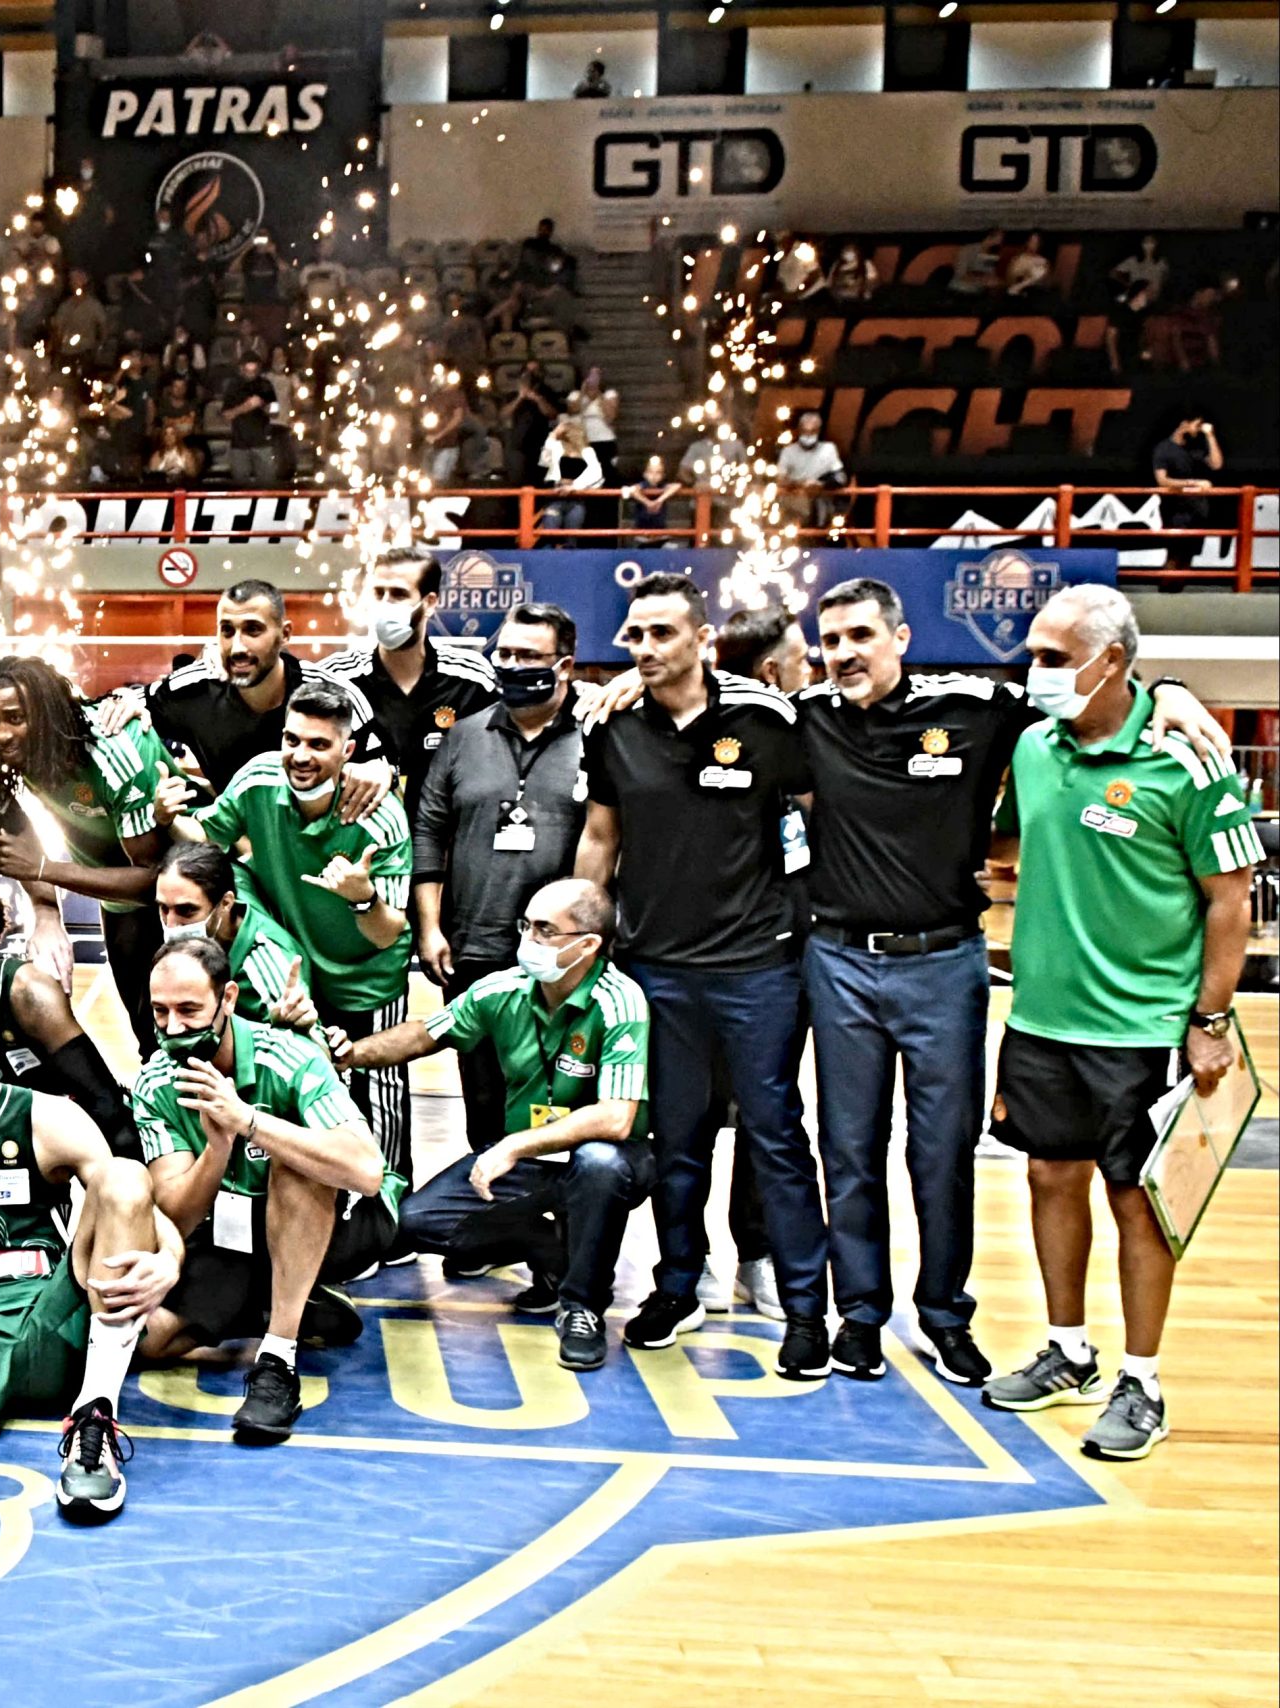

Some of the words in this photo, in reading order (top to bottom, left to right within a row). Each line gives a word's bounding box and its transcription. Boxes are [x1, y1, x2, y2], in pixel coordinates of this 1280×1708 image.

[102, 83, 328, 137] PATRAS
[594, 128, 786, 198] GTD
[960, 124, 1158, 193] GTD
[437, 589, 482, 609] UPER
[485, 588, 524, 609] CUP
[953, 588, 1017, 610] SUPER
[1020, 588, 1058, 609] CU
